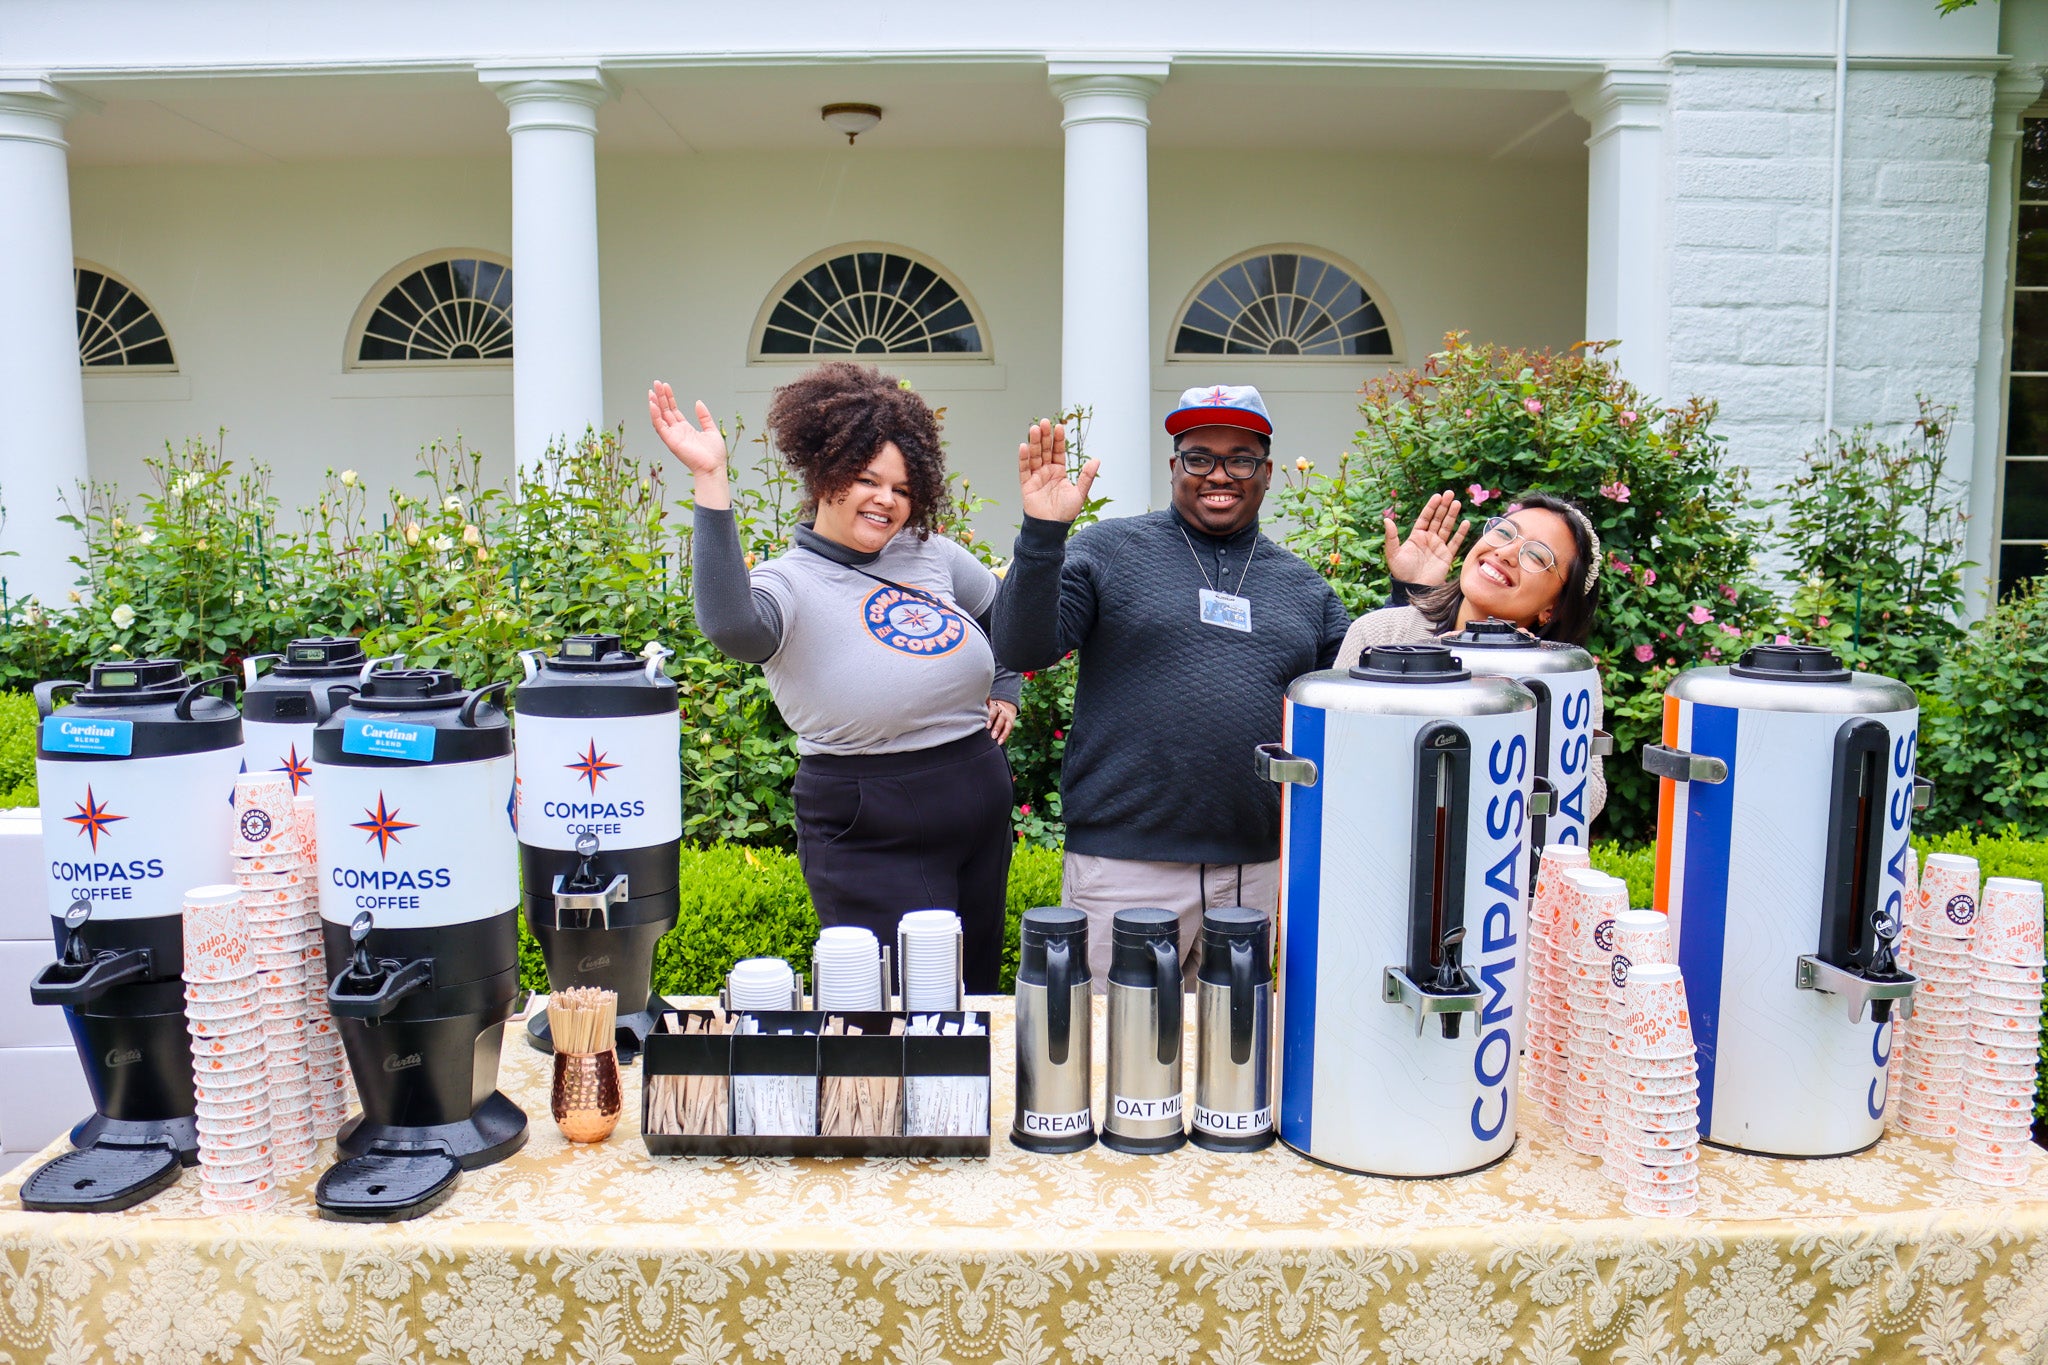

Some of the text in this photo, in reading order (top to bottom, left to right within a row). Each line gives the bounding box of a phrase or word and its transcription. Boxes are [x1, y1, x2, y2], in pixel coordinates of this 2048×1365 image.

[891, 618, 961, 652] COFFEE
[61, 722, 115, 737] Cardinal
[361, 724, 418, 742] Cardinal
[74, 736, 100, 744] BLEND
[375, 739, 402, 748] BLEND
[544, 800, 645, 819] COMPASS
[566, 823, 622, 835] COFFEE
[52, 859, 164, 882] COMPASS
[332, 867, 451, 890] COMPASS
[71, 887, 133, 901] COFFEE
[355, 895, 420, 909] COFFEE
[1868, 729, 1916, 1120] COPASS
[2006, 920, 2035, 939] COFFEE
[197, 932, 227, 956] COFFEE
[213, 937, 239, 958] GOOD
[1471, 734, 1527, 1141] COMPASS
[226, 943, 247, 966] REAL
[1633, 1018, 1657, 1035] GOOD
[1643, 1026, 1667, 1046] REAL
[737, 1087, 745, 1125] WHITE
[1116, 1096, 1182, 1117] OAT MIL
[1026, 1112, 1088, 1132] CREAM
[1254, 1113, 1271, 1128] MIL
